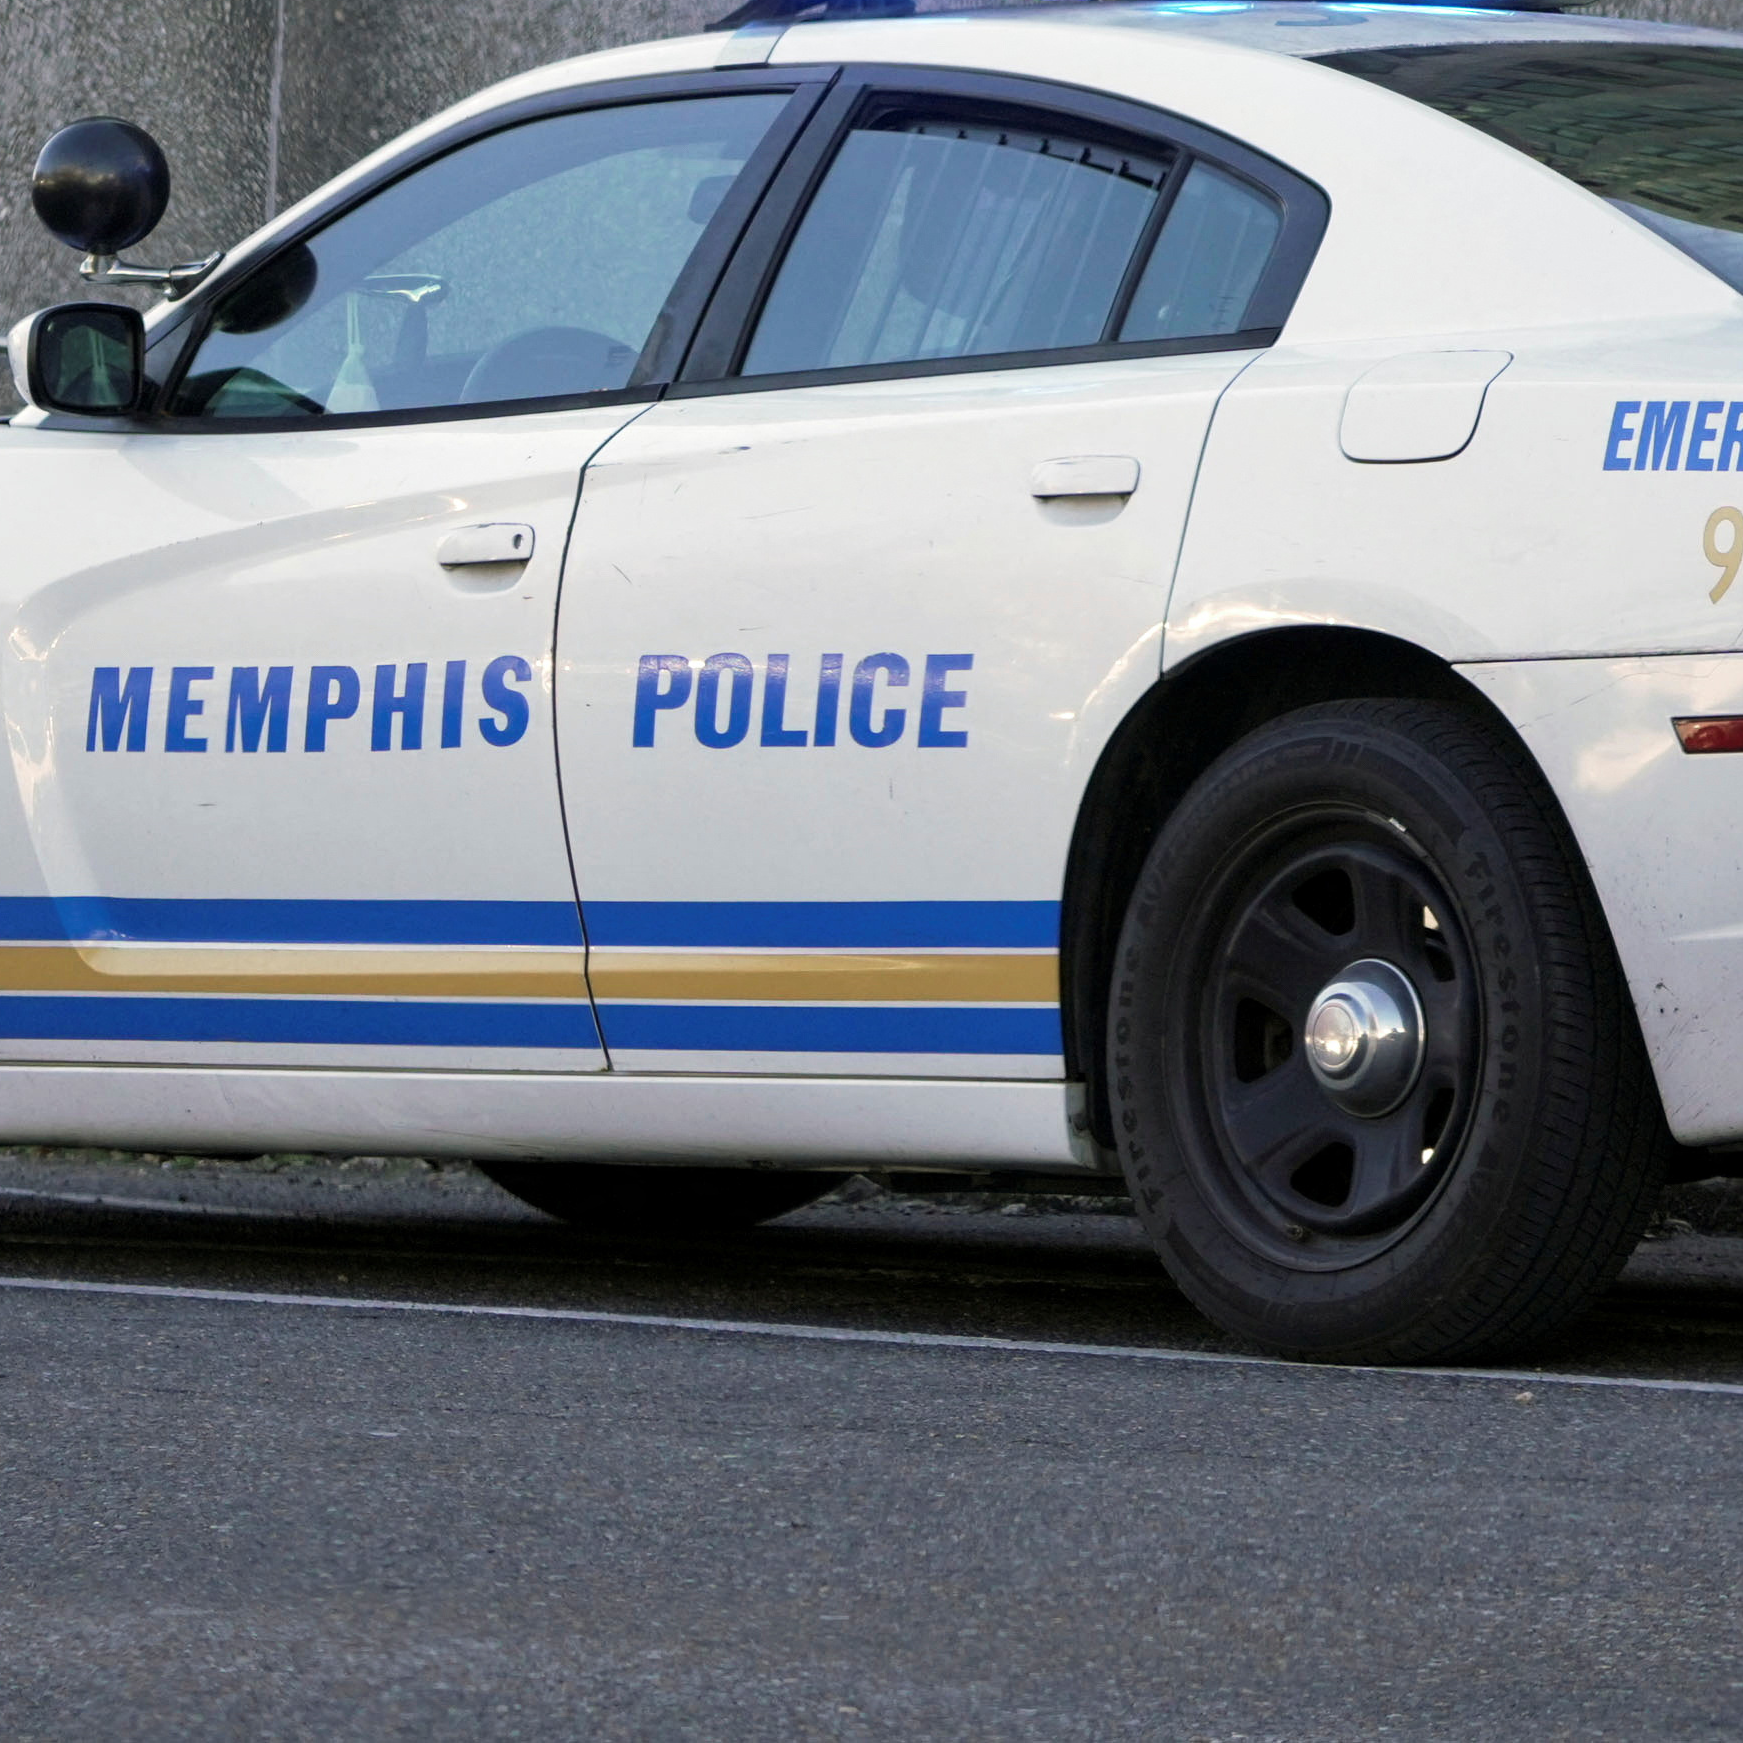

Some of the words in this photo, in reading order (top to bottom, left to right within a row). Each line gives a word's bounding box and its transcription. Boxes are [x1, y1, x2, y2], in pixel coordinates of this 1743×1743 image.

[85, 655, 532, 753] MEMPHIS
[632, 652, 974, 749] POLICE
[1114, 941, 1166, 1215] Firestone
[1463, 850, 1522, 1124] Firestone
